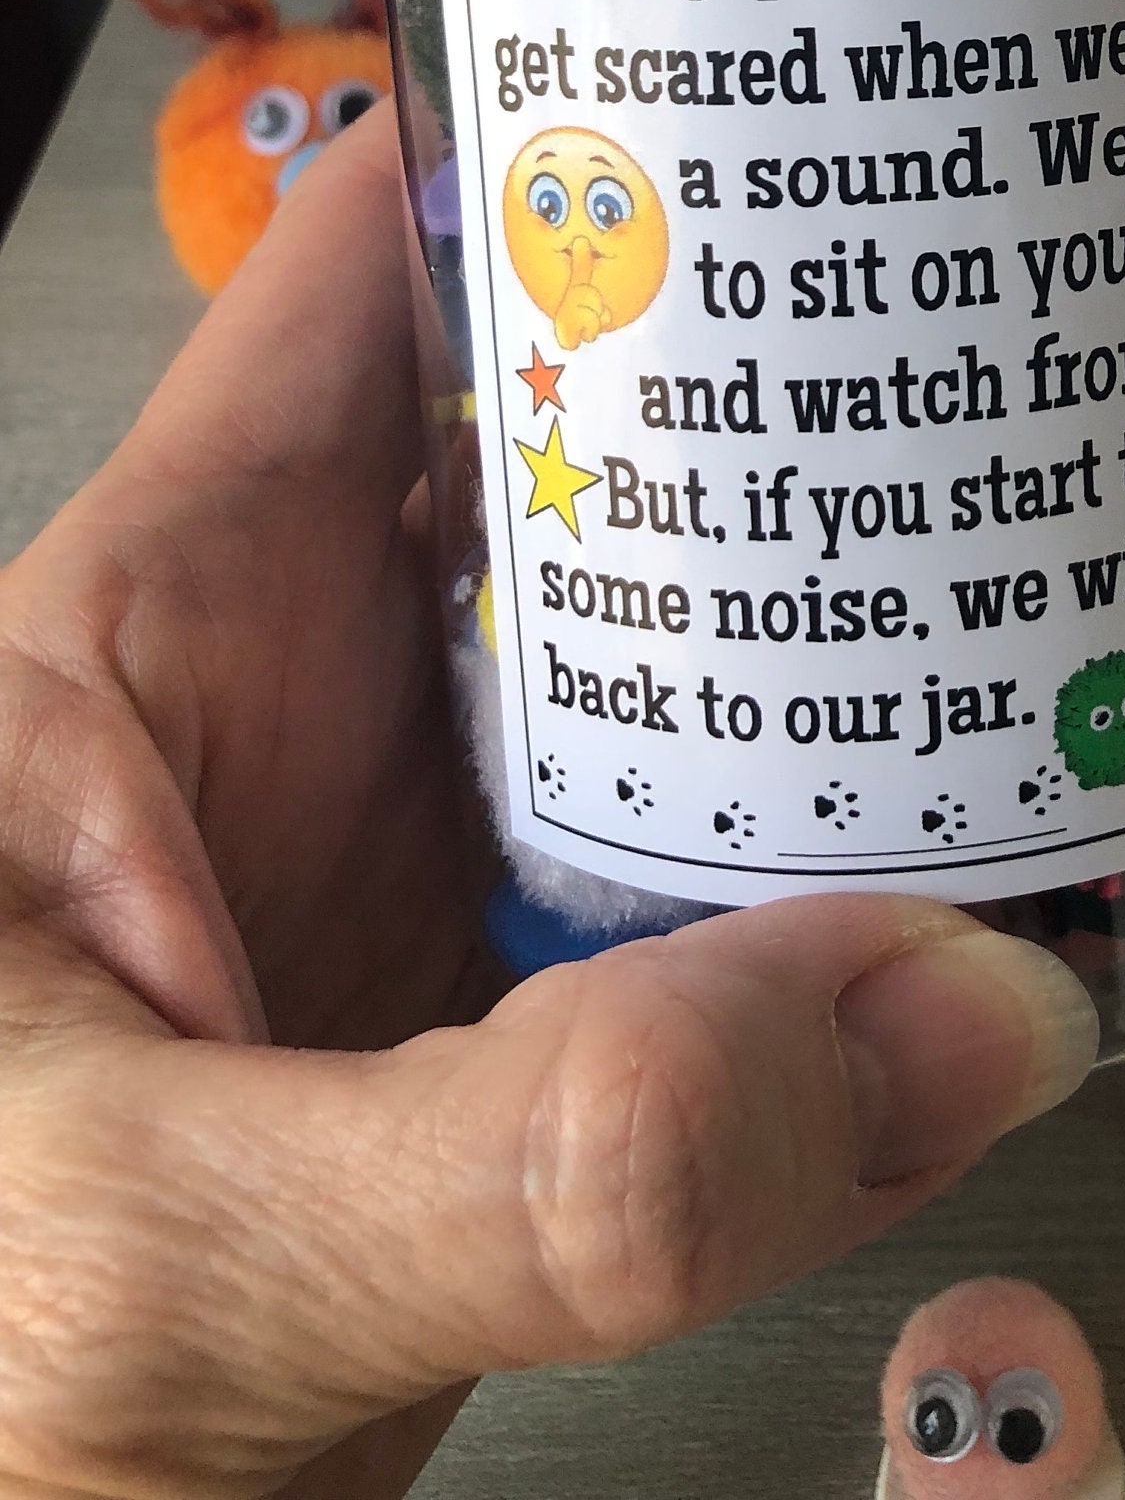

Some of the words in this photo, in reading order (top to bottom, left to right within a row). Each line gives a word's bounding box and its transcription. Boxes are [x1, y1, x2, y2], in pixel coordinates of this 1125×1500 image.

[493, 28, 579, 112] get
[593, 27, 826, 108] scared
[843, 22, 1039, 103] when
[676, 153, 722, 211] a
[745, 128, 1009, 209] sound.
[695, 242, 765, 320] to
[790, 239, 900, 320] sit
[911, 252, 1000, 306] on
[637, 358, 768, 436] and
[784, 345, 1008, 436] watch
[601, 455, 728, 544] But,
[743, 469, 800, 544] if
[809, 483, 929, 559] you
[948, 444, 1104, 533] start
[539, 558, 692, 638] some
[709, 573, 931, 645] noise,
[948, 573, 1050, 633] we
[543, 642, 679, 734] back
[695, 675, 764, 744] to
[784, 691, 901, 745] our
[915, 673, 1037, 755] jar.
